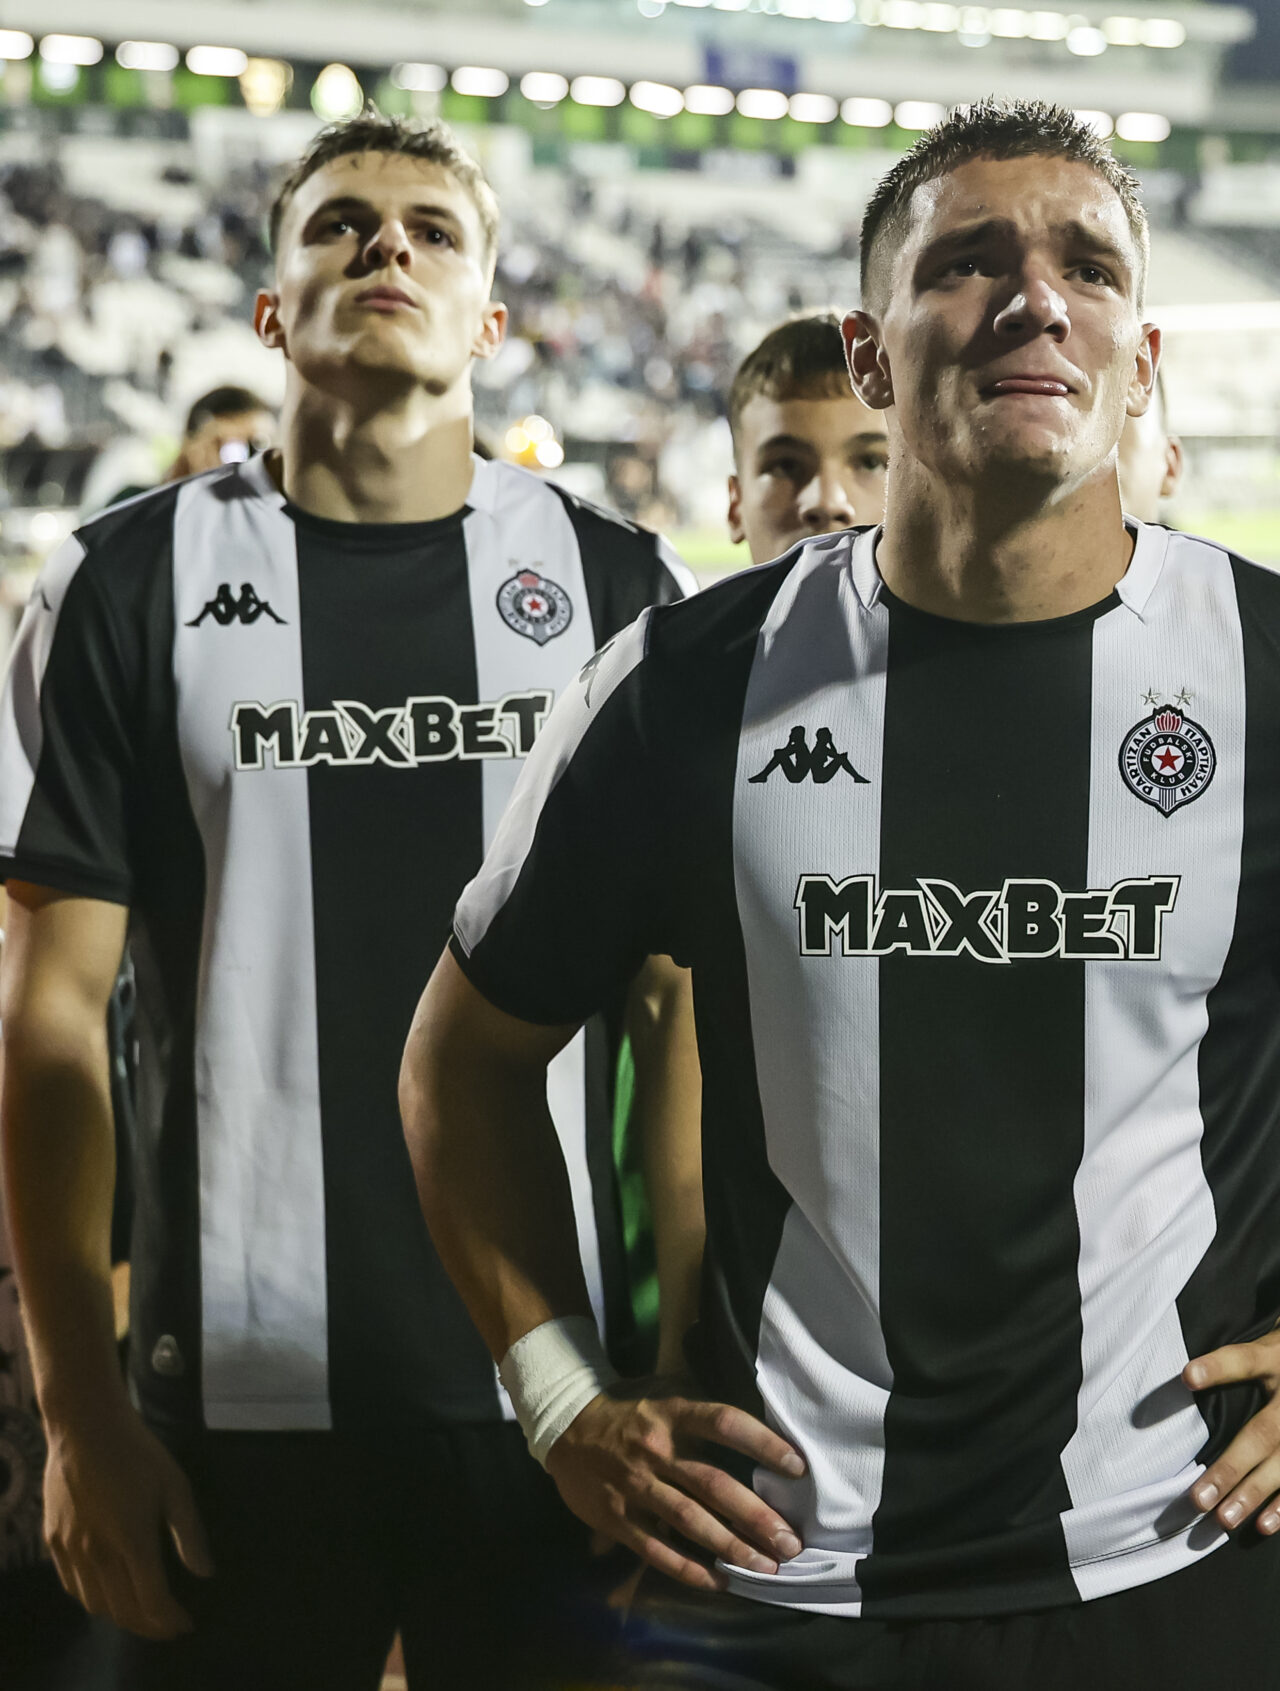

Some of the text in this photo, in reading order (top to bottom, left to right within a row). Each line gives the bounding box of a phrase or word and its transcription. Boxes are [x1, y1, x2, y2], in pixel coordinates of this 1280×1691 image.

[229, 689, 555, 770] MAXBET
[1126, 727, 1154, 796] PARTIZAN
[1142, 736, 1193, 763] FUDBALSKI
[1180, 727, 1209, 797] ПАРТИЗАН
[1150, 772, 1185, 784] KLUB
[794, 874, 1182, 964] MAXBET
